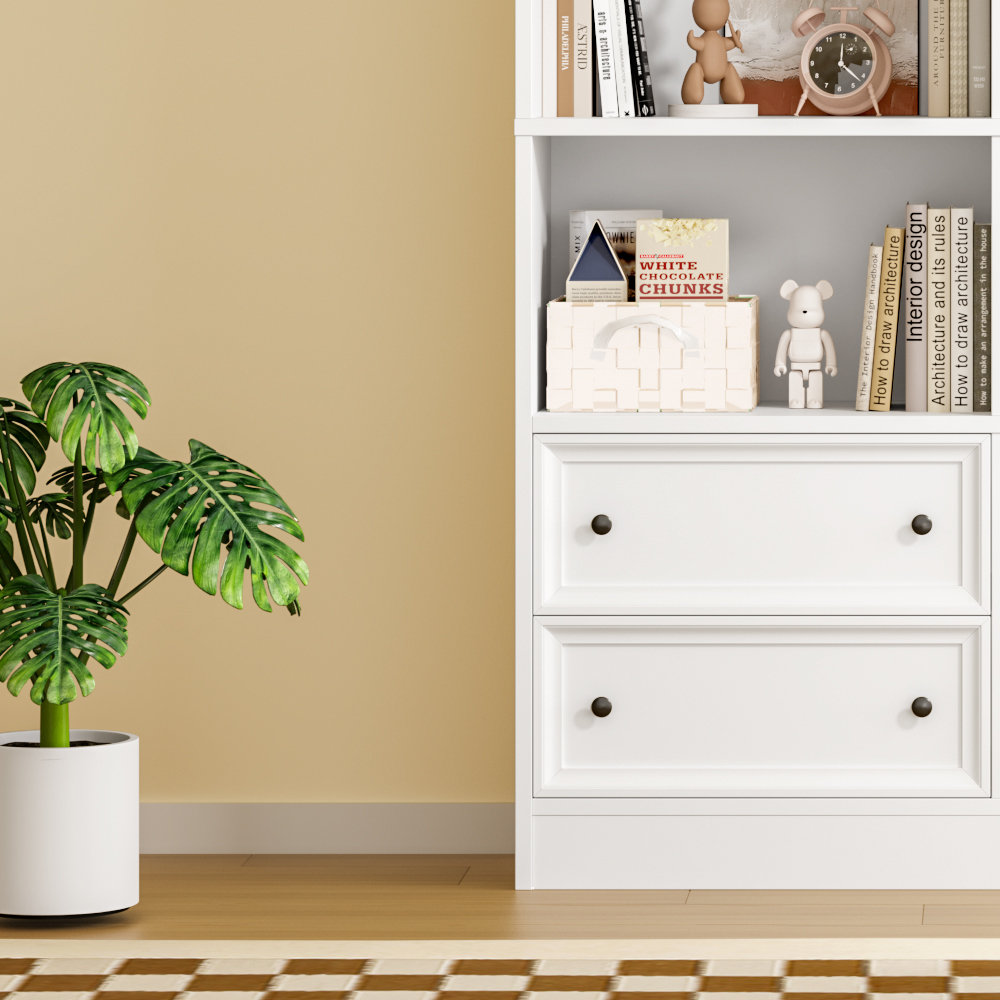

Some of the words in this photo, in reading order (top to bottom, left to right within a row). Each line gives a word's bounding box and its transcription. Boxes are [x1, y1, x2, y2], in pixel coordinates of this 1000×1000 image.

[600, 37, 611, 80] architecture
[906, 212, 927, 273] design
[932, 215, 945, 252] rules
[979, 228, 987, 252] house
[639, 261, 697, 270] WHITE
[869, 254, 879, 295] Handbook
[883, 235, 900, 316] architecture
[932, 258, 945, 275] its
[955, 216, 968, 306] architecture
[979, 255, 987, 270] the
[639, 273, 724, 281] CHOCOLATE
[639, 283, 724, 295] CHUNKS
[979, 273, 987, 284] in
[932, 281, 945, 308] and
[866, 302, 875, 331] Design
[906, 277, 923, 342] Interior
[980, 287, 988, 337] arrangement
[879, 320, 893, 354] draw
[955, 313, 968, 348] draw
[861, 338, 873, 377] Interior
[932, 314, 945, 406] Architecture
[981, 341, 987, 351] an
[877, 357, 889, 370] to
[955, 354, 968, 368] to
[859, 382, 868, 397] The
[874, 377, 888, 406] How
[955, 375, 968, 407] How
[980, 377, 987, 386] to
